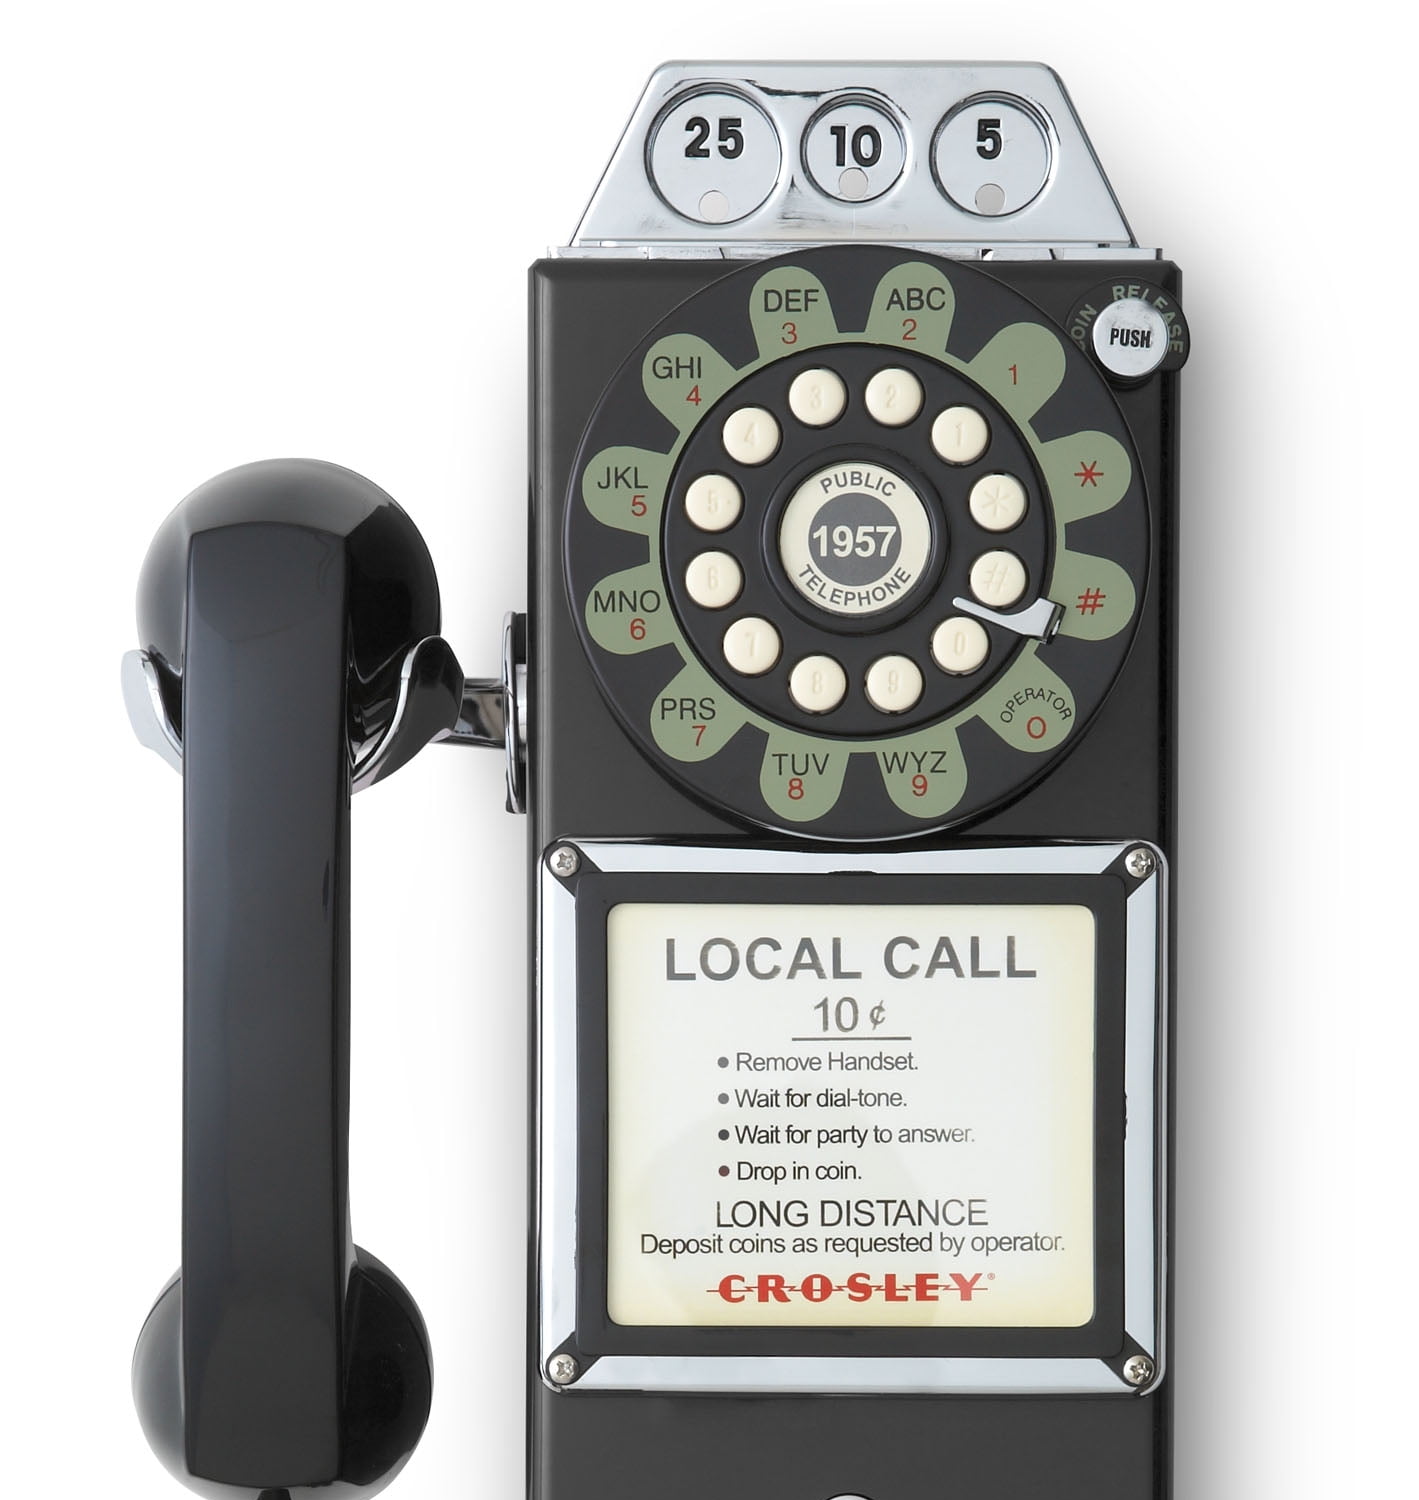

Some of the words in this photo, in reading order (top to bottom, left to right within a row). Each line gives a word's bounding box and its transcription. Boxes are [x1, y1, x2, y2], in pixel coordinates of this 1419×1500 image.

[684, 117, 744, 159] 25
[829, 124, 882, 167] 10
[976, 118, 1002, 160] 5
[763, 289, 819, 313] DEF
[886, 286, 946, 312] ABC
[781, 322, 798, 345] 3
[902, 318, 917, 341] 2
[1109, 327, 1152, 349] PUSH
[652, 356, 702, 379] GHI
[1008, 364, 1018, 386] 1
[686, 385, 702, 407] 4
[597, 466, 649, 490] JKL
[819, 470, 897, 498] PUBLIC
[631, 494, 648, 517] 5
[812, 524, 898, 558] 1957
[798, 563, 912, 607] TELEPHONE
[593, 589, 661, 613] MNO
[1075, 587, 1106, 615] #
[630, 618, 647, 641] 6
[660, 697, 716, 721] PRS
[1000, 687, 1072, 724] OPERATOR
[692, 725, 707, 747] 7
[772, 753, 830, 776] TUV
[882, 751, 947, 774] WYZ
[787, 777, 804, 801] 8
[911, 774, 928, 797] 9
[665, 936, 862, 981] LOCAL
[884, 935, 1037, 980] CALL
[813, 996, 859, 1033] 10
[736, 1051, 822, 1071] Remove
[828, 1051, 918, 1071] Handset.
[735, 1088, 780, 1108] Wait
[785, 1088, 811, 1108] for
[816, 1088, 907, 1108] dial-tone.
[735, 1125, 780, 1144] Wait
[785, 1124, 811, 1144] for
[817, 1124, 868, 1148] party
[873, 1126, 893, 1144] to
[898, 1127, 976, 1144] answer.
[737, 1161, 787, 1185] Drop
[792, 1161, 809, 1180] in
[815, 1161, 862, 1180] coin.
[716, 1200, 809, 1228] LONG
[820, 1199, 989, 1227] DISTANCE
[641, 1233, 723, 1259] Deposit
[729, 1233, 786, 1254] coins
[792, 1237, 818, 1254] as
[824, 1232, 933, 1258] requested
[939, 1232, 965, 1257] by
[970, 1233, 1066, 1257] operator.
